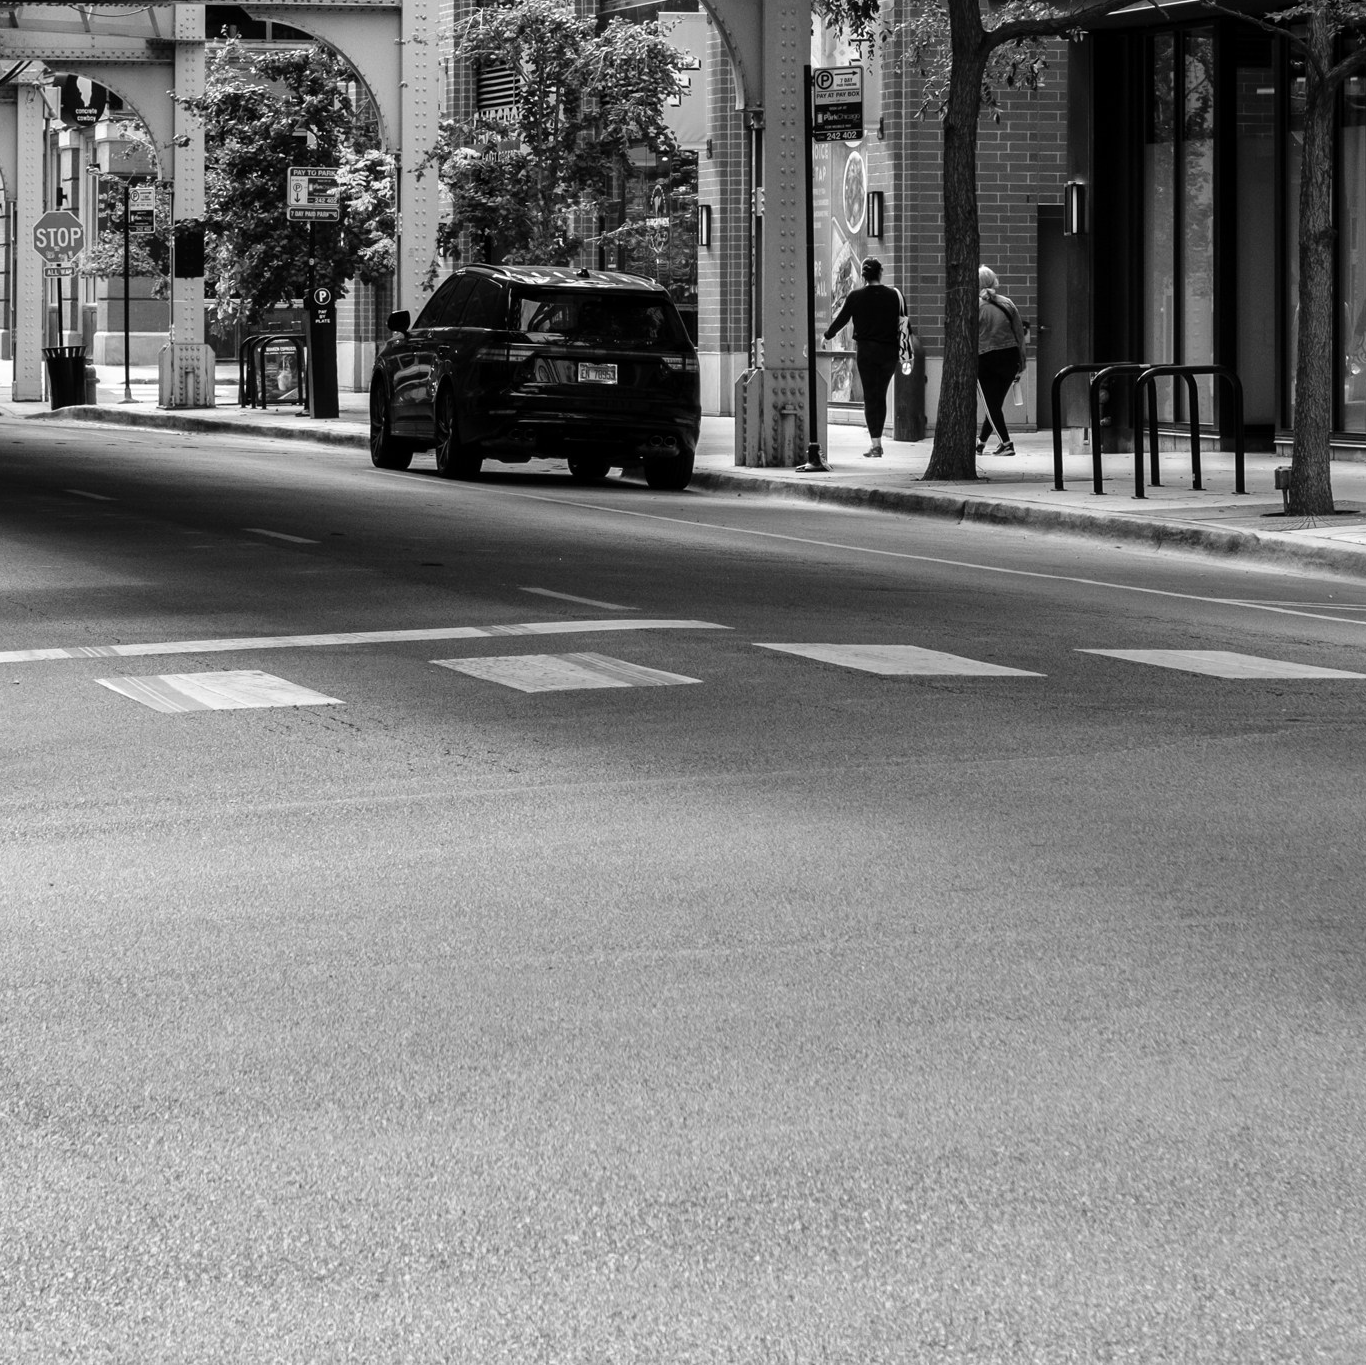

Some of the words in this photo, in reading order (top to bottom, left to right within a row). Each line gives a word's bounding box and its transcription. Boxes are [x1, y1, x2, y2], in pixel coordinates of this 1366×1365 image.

[821, 75, 829, 86] P
[824, 113, 860, 122] ParkChicago
[843, 131, 857, 139] 402
[36, 228, 81, 247] STOP
[319, 290, 327, 302] P
